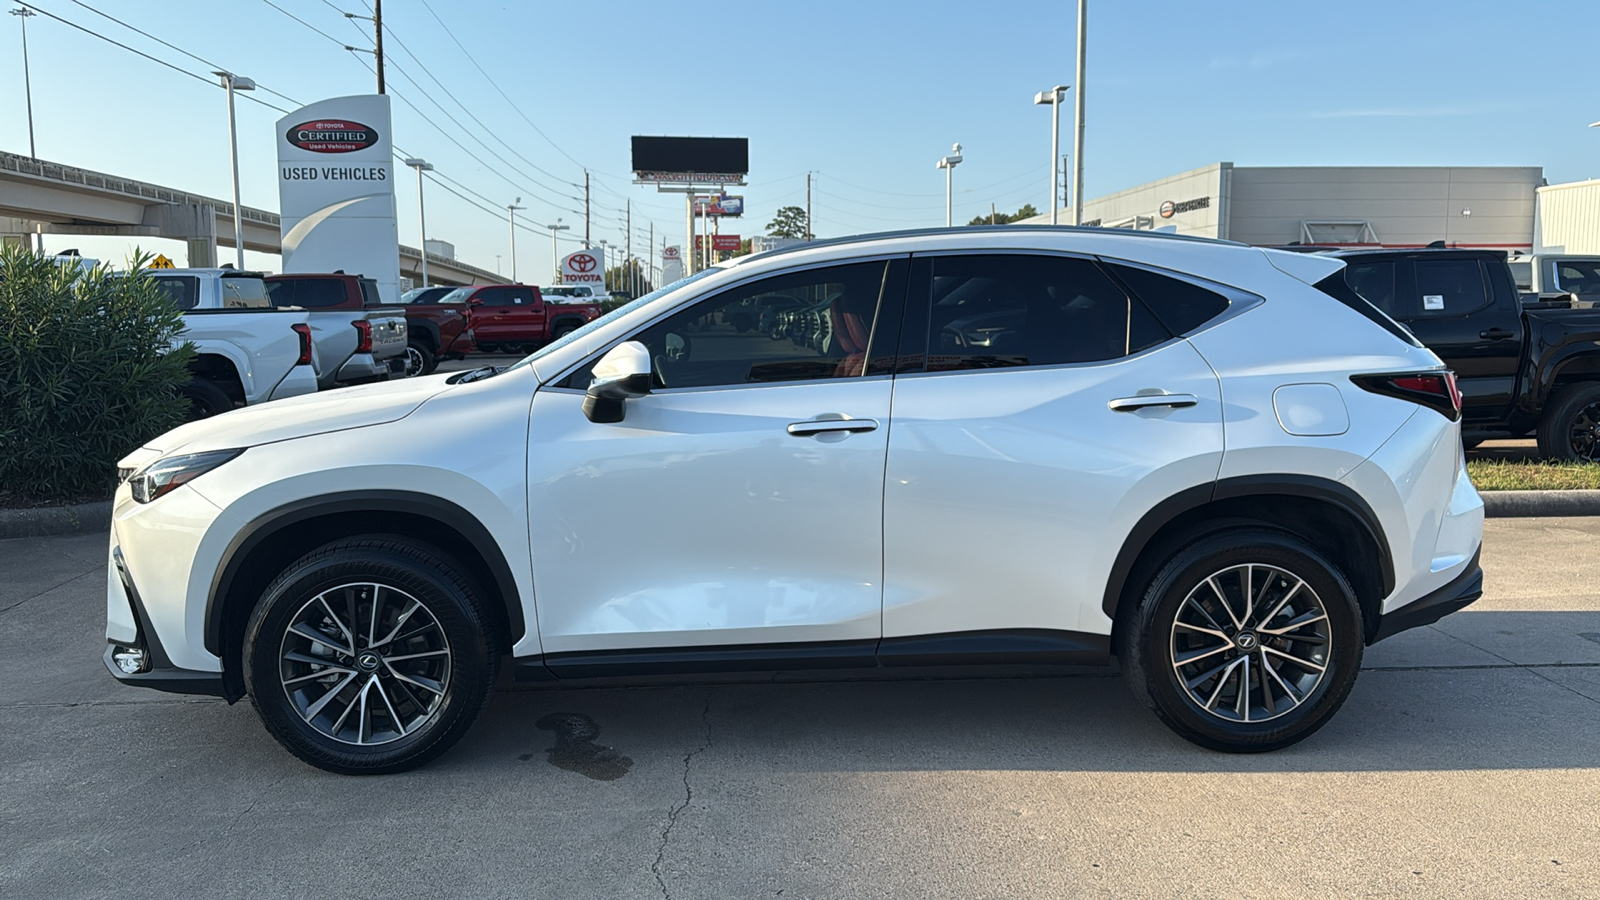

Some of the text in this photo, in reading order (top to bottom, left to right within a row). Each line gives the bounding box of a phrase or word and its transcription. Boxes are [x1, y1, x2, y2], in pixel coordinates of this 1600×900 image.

[298, 130, 366, 141] CERTIFIED
[283, 167, 386, 181] USED VEHICLES
[564, 274, 602, 282] TOYOTA
